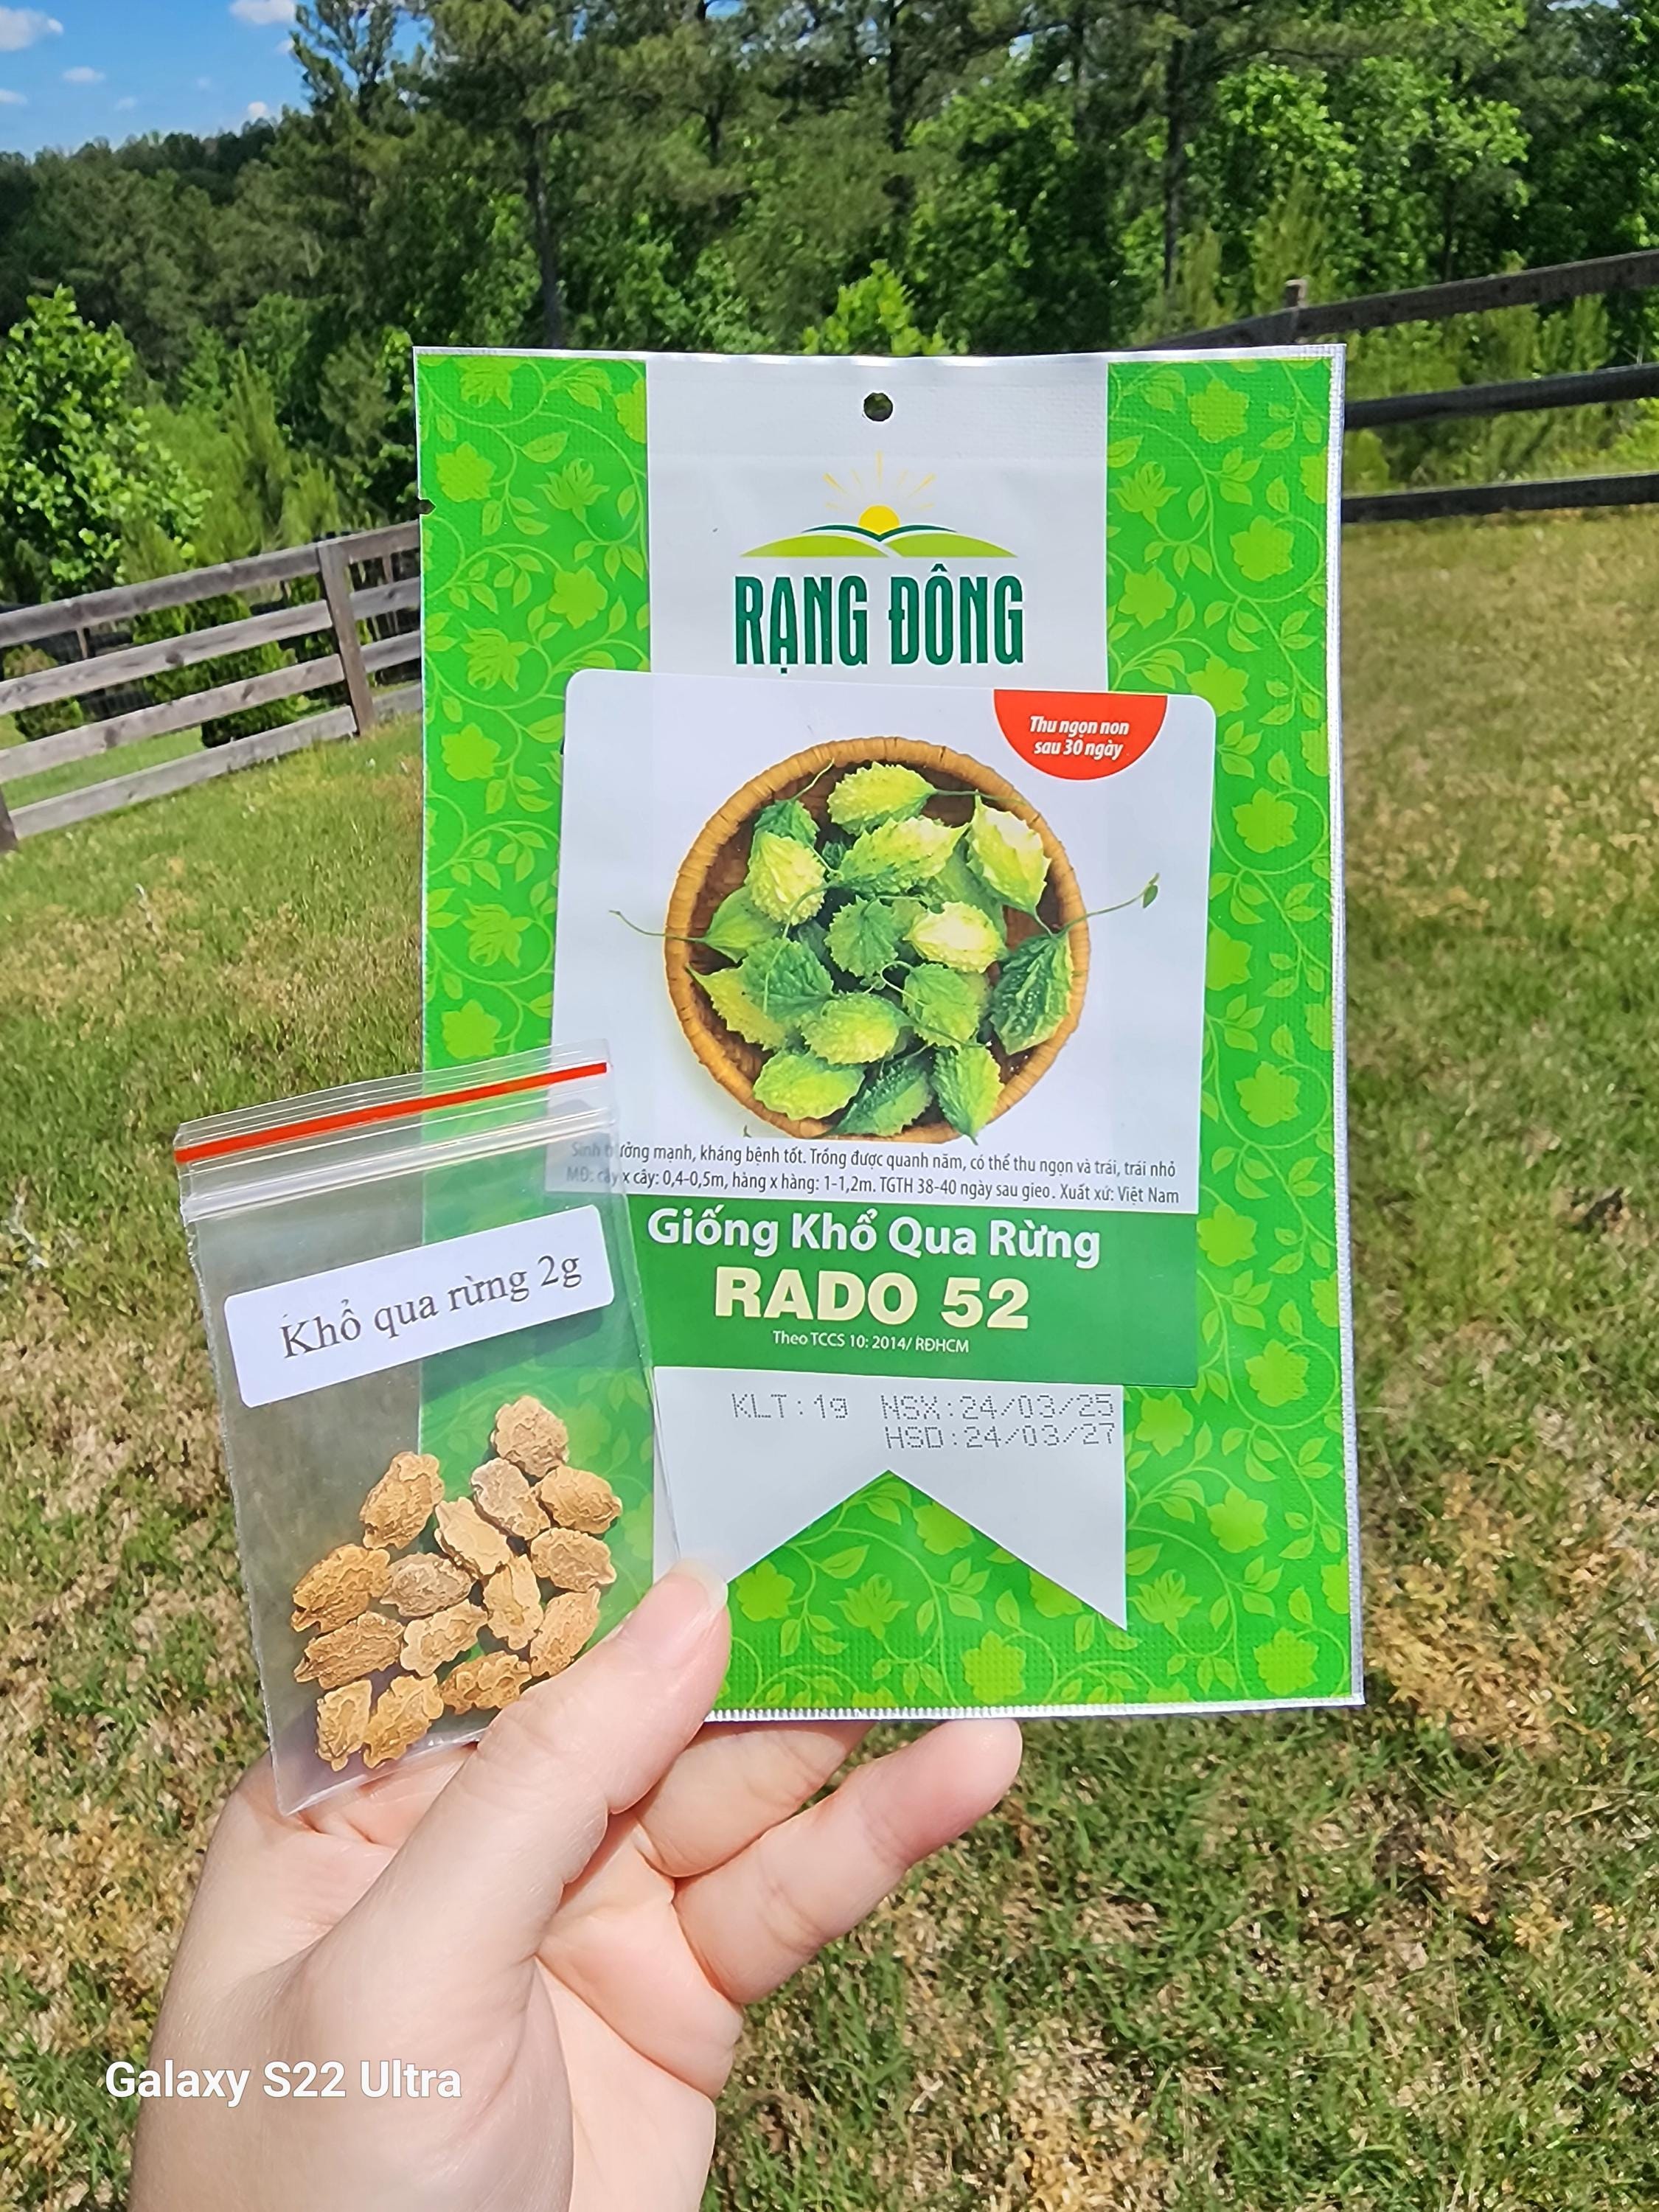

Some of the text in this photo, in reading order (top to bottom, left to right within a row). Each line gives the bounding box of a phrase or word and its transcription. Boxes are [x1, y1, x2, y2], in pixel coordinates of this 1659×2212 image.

[734, 563, 1024, 674] RẠNG ĐÔNG
[1030, 715, 1130, 738] Thu ngọn non
[1034, 739, 1124, 760] sau 30 ngày
[654, 1144, 696, 1163] mạnh,
[700, 1144, 742, 1165] kháng
[746, 1147, 779, 1166] bệnh
[784, 1145, 806, 1164] tốt.
[851, 1150, 883, 1169] được
[886, 1152, 928, 1170] quanh
[933, 1153, 966, 1171] năm,
[970, 1155, 984, 1170] có
[988, 1153, 1010, 1171] thể
[1014, 1155, 1035, 1172] thu
[1040, 1159, 1073, 1177] ngọn
[1077, 1158, 1091, 1174] và
[1095, 1159, 1120, 1177] trái,
[1124, 1161, 1147, 1176] trái
[1150, 1161, 1175, 1177] nhỏ
[622, 1172, 630, 1183] x
[633, 1169, 658, 1189] cây:
[663, 1171, 728, 1190] 0,4-0,5m,
[732, 1172, 766, 1193] hàng
[770, 1178, 777, 1189] x
[782, 1173, 819, 1194] hàng:
[824, 1175, 876, 1194] 1-1,2m.
[880, 1176, 913, 1192] TGTH
[918, 1178, 956, 1194] 38-40
[961, 1180, 992, 1200] ngày
[996, 1183, 1018, 1197] sau
[1060, 1183, 1090, 1200] Xuất
[1118, 1186, 1143, 1206] Việt
[1148, 1187, 1179, 1203] Nam
[647, 1205, 1102, 1268] Giống Khổ Qua Rừng
[280, 1255, 582, 1359] Khổ qua rừng 2g
[714, 1266, 1030, 1329] RADO 52
[773, 1330, 808, 1345] Theo
[810, 1332, 846, 1347] TCCS
[850, 1335, 869, 1349] 10:
[872, 1335, 912, 1352] 2014/
